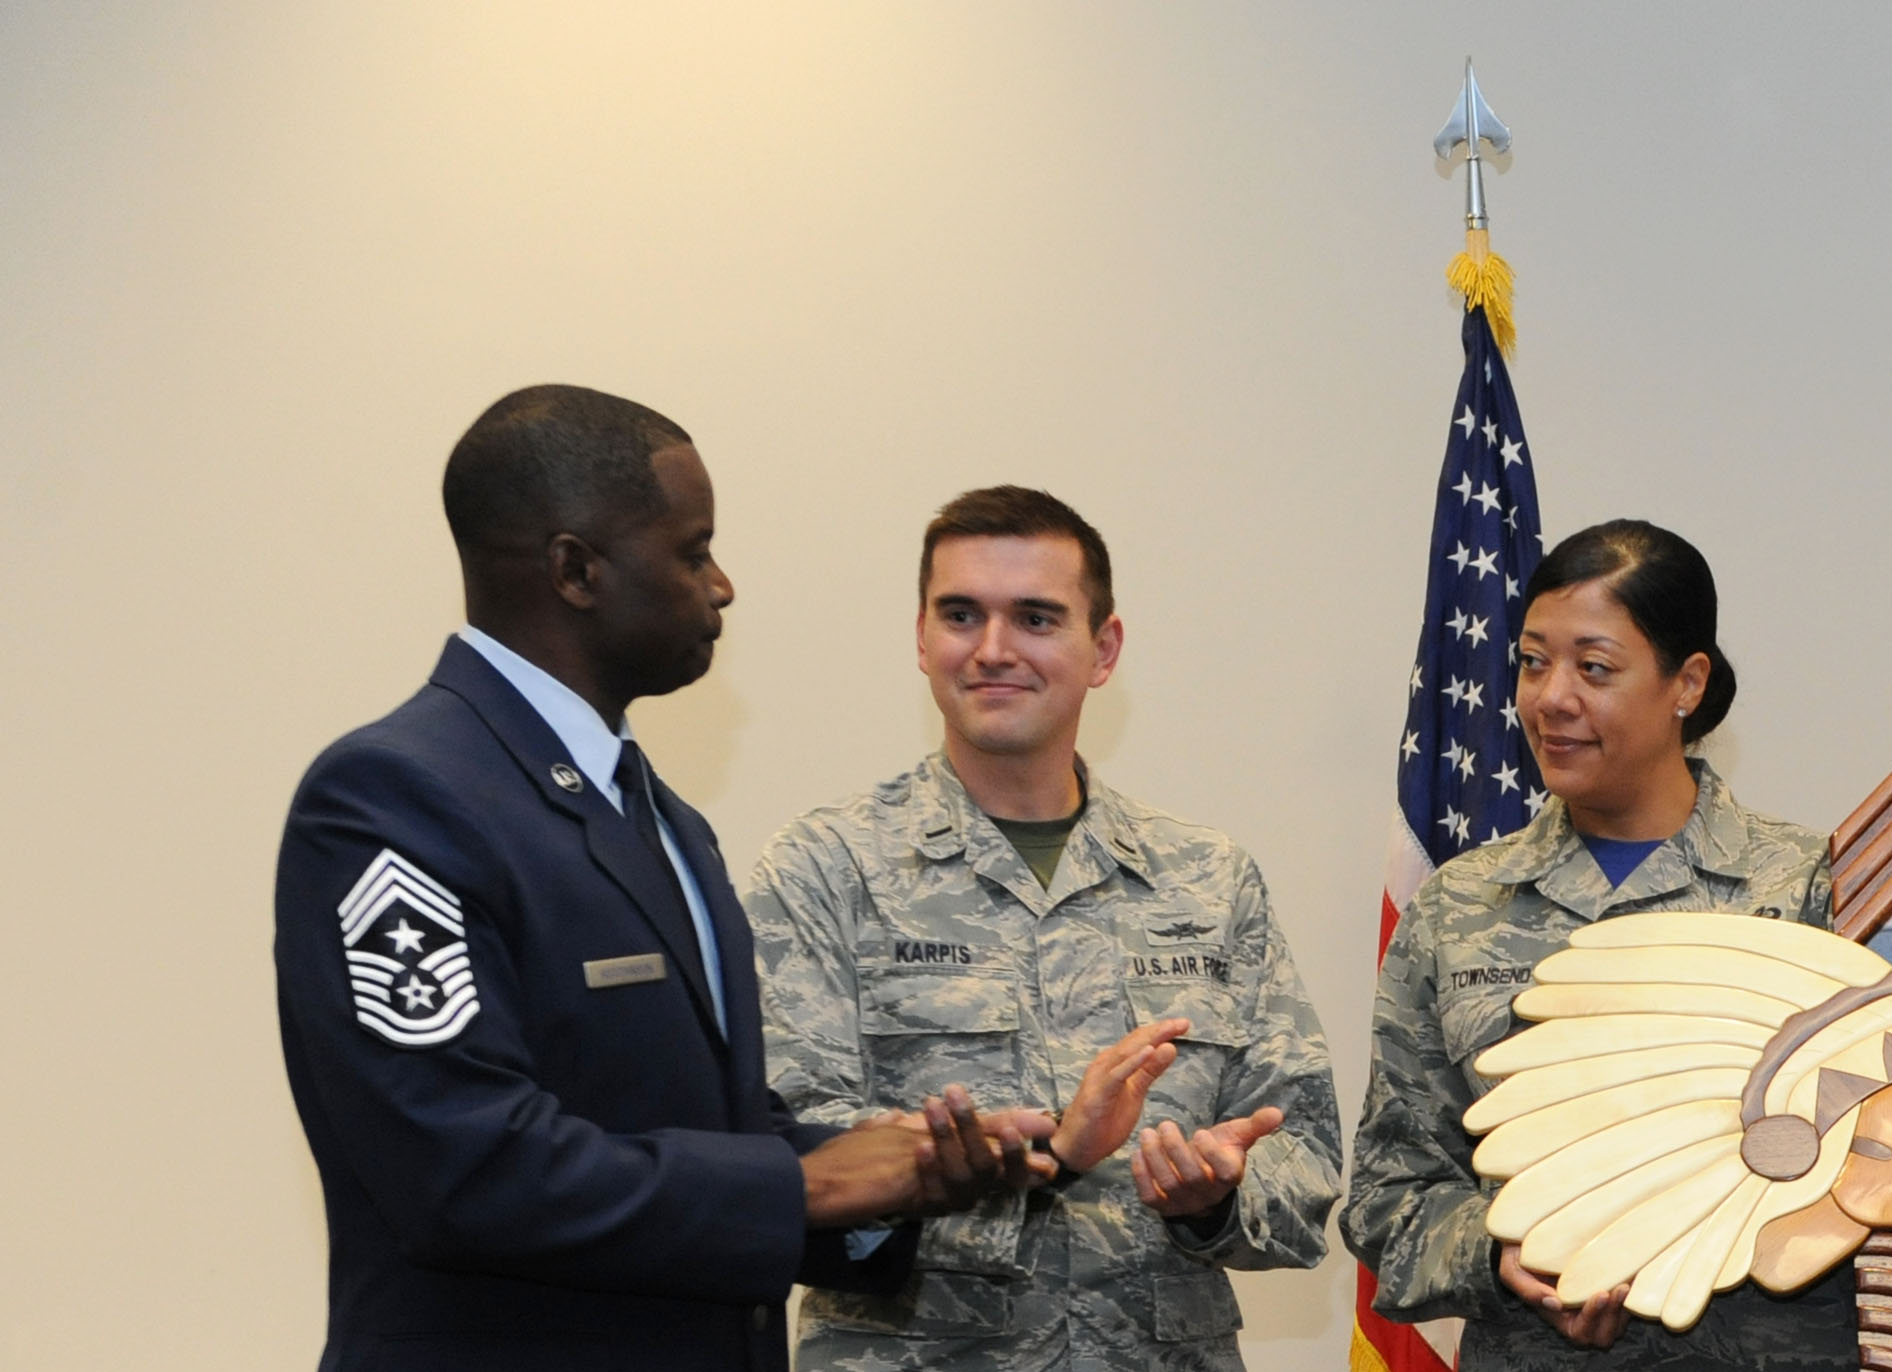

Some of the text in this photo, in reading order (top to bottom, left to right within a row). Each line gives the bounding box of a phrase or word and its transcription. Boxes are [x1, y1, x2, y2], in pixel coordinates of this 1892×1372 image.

[895, 942, 971, 964] KARPIS
[1133, 957, 1168, 977] U.S.
[1172, 956, 1199, 976] AIR
[1450, 966, 1532, 991] TOWNSEND
